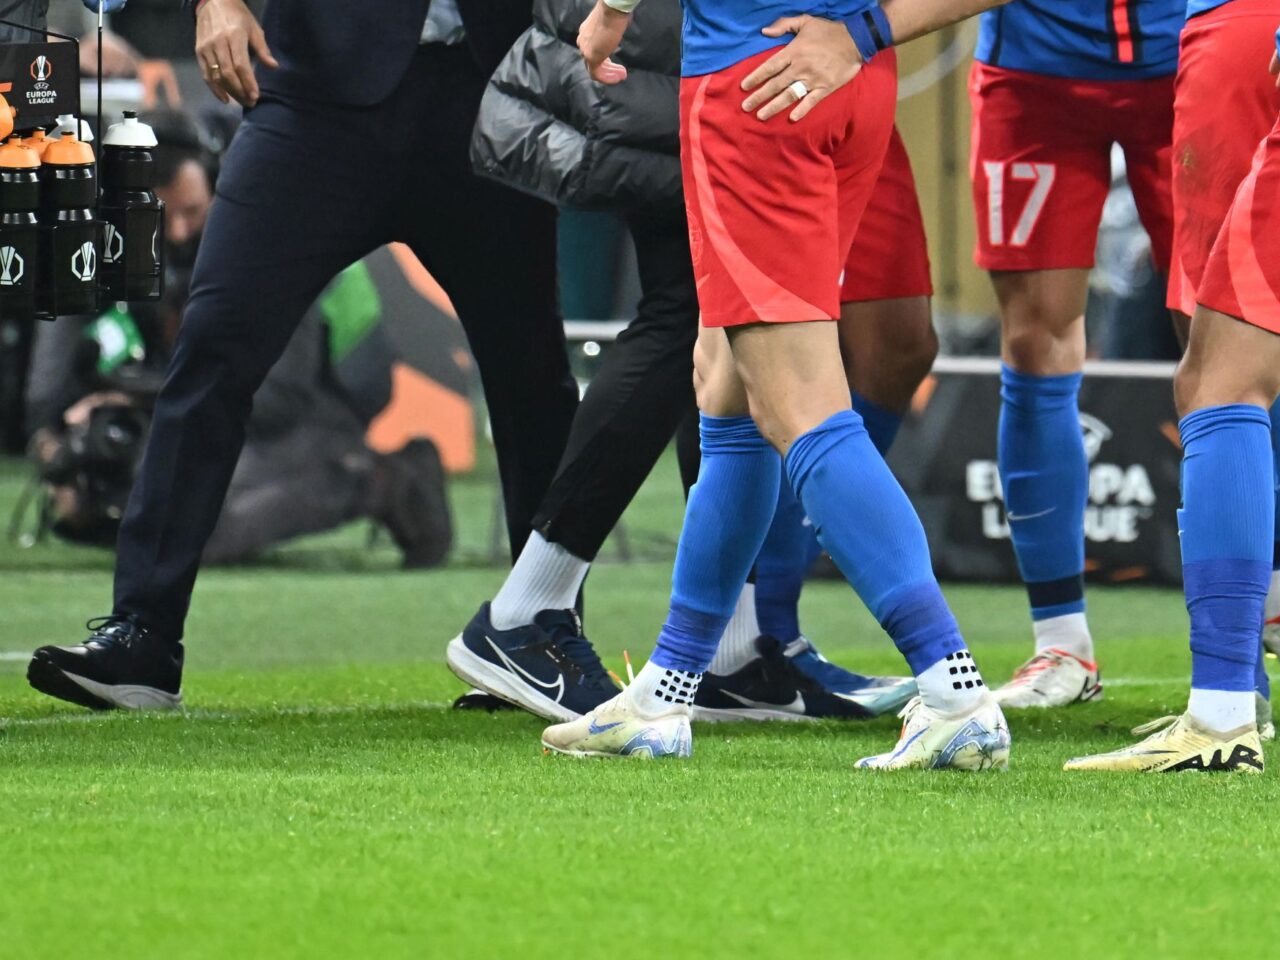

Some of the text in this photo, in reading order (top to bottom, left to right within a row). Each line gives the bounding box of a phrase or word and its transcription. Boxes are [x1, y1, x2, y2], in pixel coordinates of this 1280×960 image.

[26, 90, 57, 99] EUROPA
[28, 97, 55, 105] LEAGUE
[982, 160, 1056, 246] 17
[966, 459, 1156, 506] EPA
